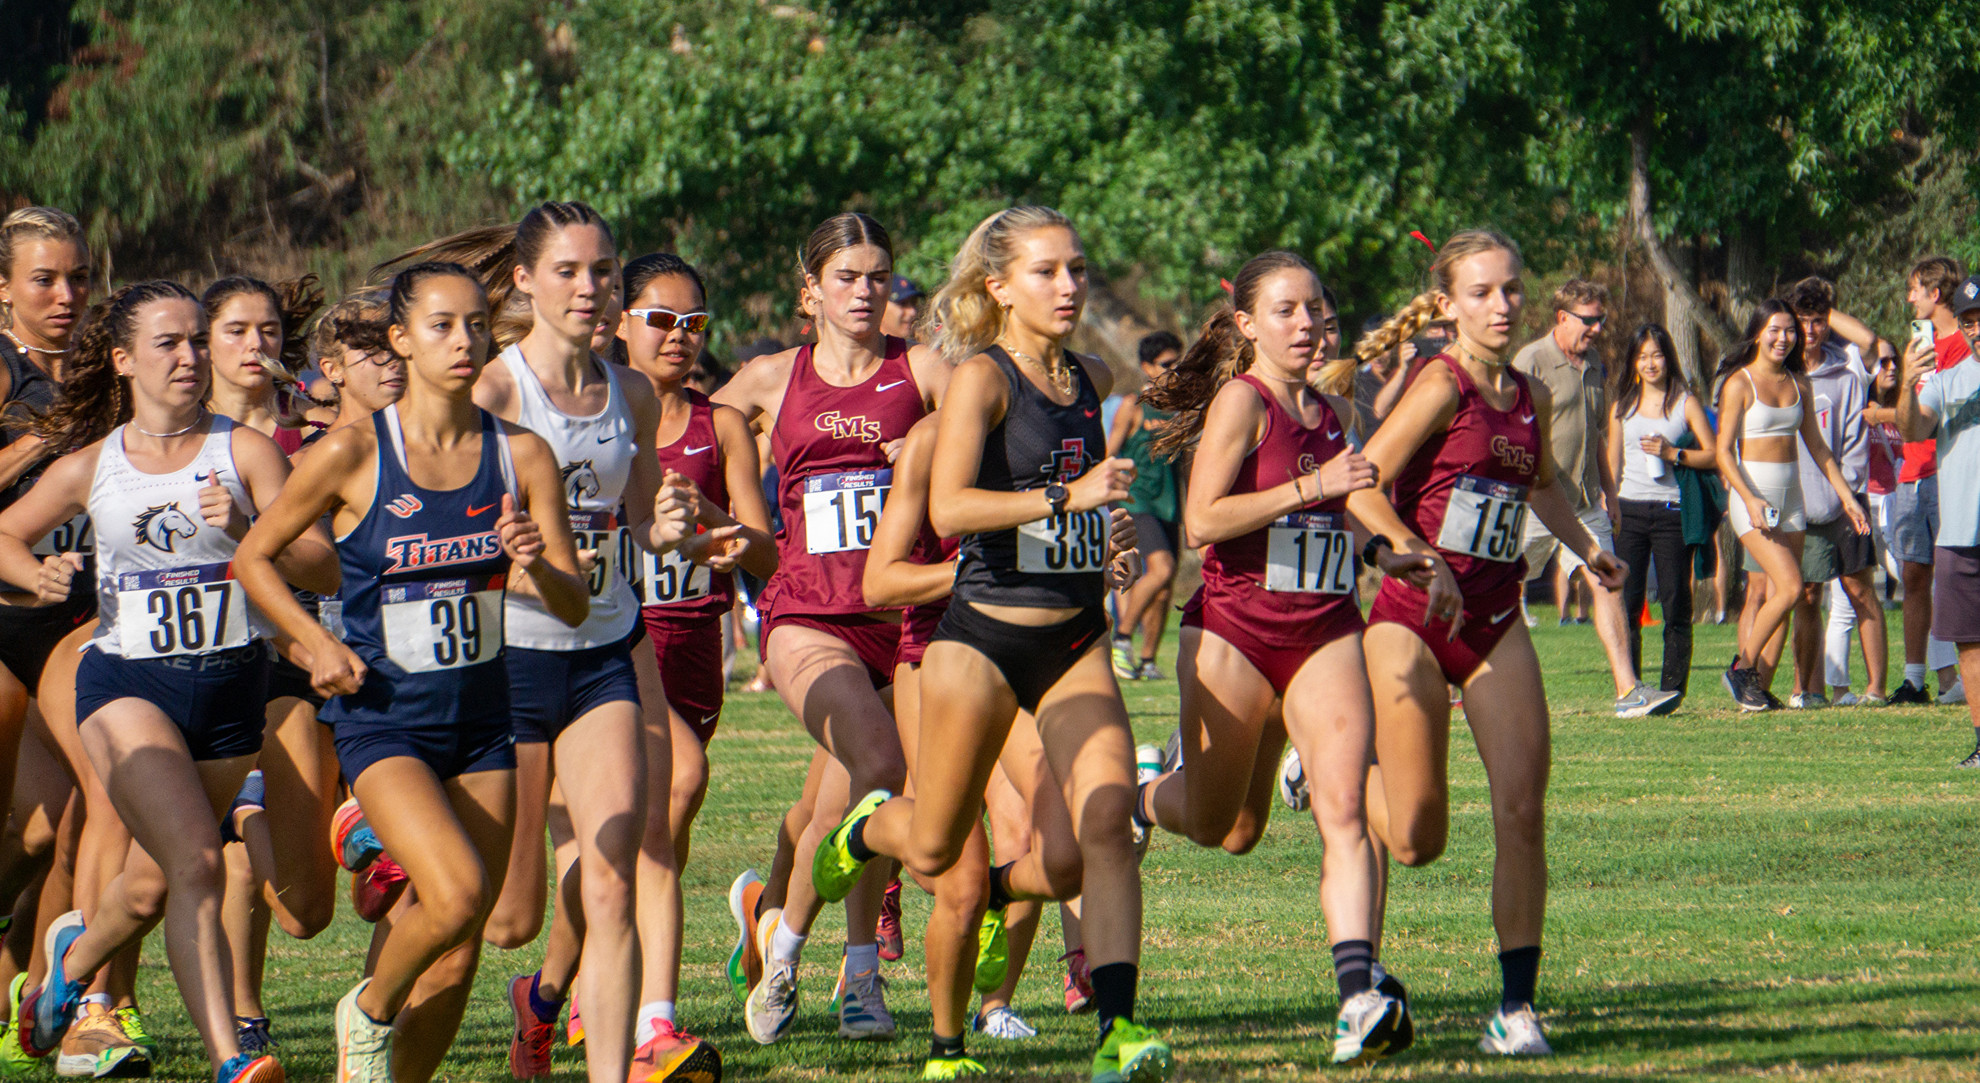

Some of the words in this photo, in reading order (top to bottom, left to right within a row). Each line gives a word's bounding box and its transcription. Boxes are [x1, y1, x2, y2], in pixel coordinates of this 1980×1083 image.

[814, 410, 881, 443] CMS
[1490, 435, 1535, 476] CMS
[844, 480, 875, 488] RESULTS
[845, 473, 875, 481] FINISHED
[830, 488, 892, 549] 15
[1470, 498, 1527, 559] 159
[382, 531, 503, 575] TITANS
[1045, 509, 1105, 570] 339
[166, 569, 200, 578] FINISHED
[1294, 531, 1348, 590] 172
[164, 577, 199, 587] RESULTS
[432, 587, 466, 597] RESULTS
[434, 579, 467, 589] FINISHED
[147, 582, 232, 654] 367
[430, 595, 481, 667] 39
